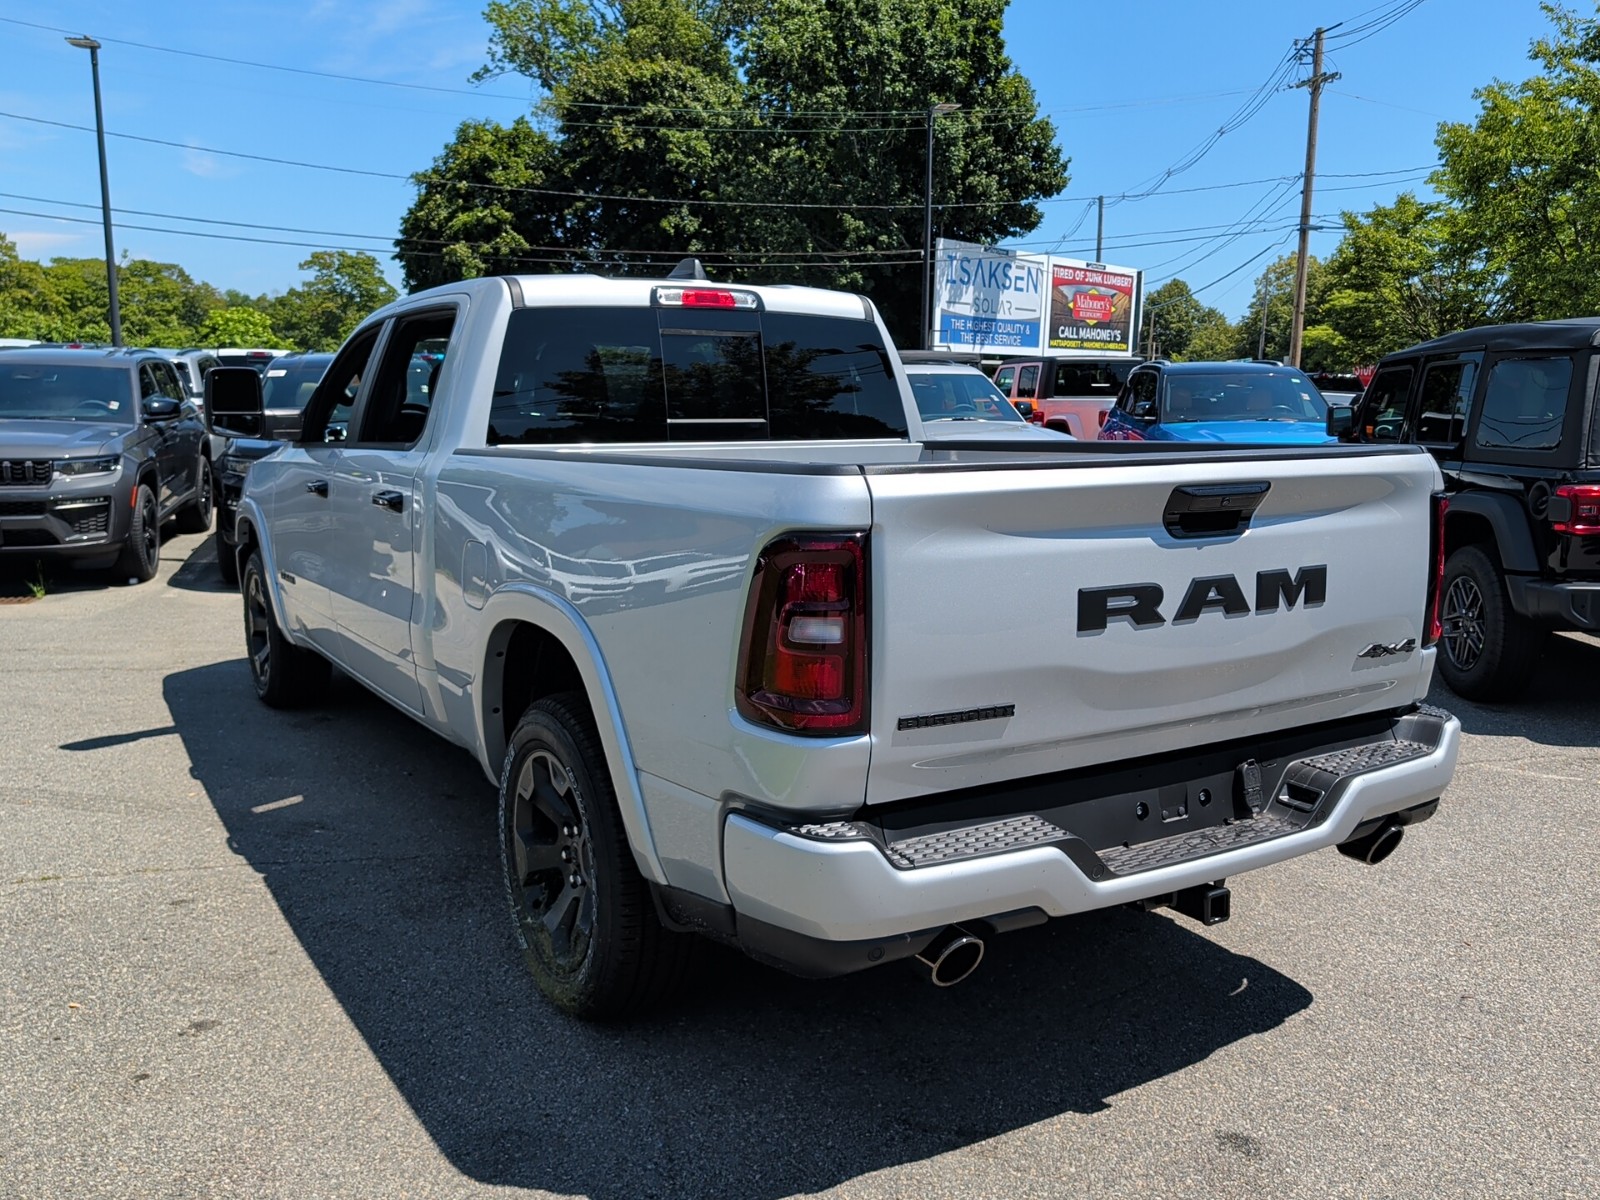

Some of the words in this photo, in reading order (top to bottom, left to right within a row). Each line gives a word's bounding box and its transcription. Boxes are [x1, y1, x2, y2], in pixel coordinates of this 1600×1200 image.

[946, 254, 1039, 294] ISAKSEN
[1053, 267, 1074, 279] TIRED
[1074, 270, 1085, 281] OF
[1085, 271, 1103, 284] JUNK
[1103, 274, 1132, 288] LUMBER?
[973, 297, 1012, 315] SOLAR
[1076, 295, 1110, 310] Mahoney's
[951, 318, 965, 330] THE
[966, 321, 996, 333] HIGHEST
[997, 322, 1024, 335] QUALITY
[1058, 325, 1077, 338] CALL
[1079, 327, 1122, 341] MAHONEY'S
[960, 331, 975, 343] THE
[975, 333, 994, 345] BEST
[994, 333, 1022, 346] SERVICE
[1077, 564, 1327, 632] RAM
